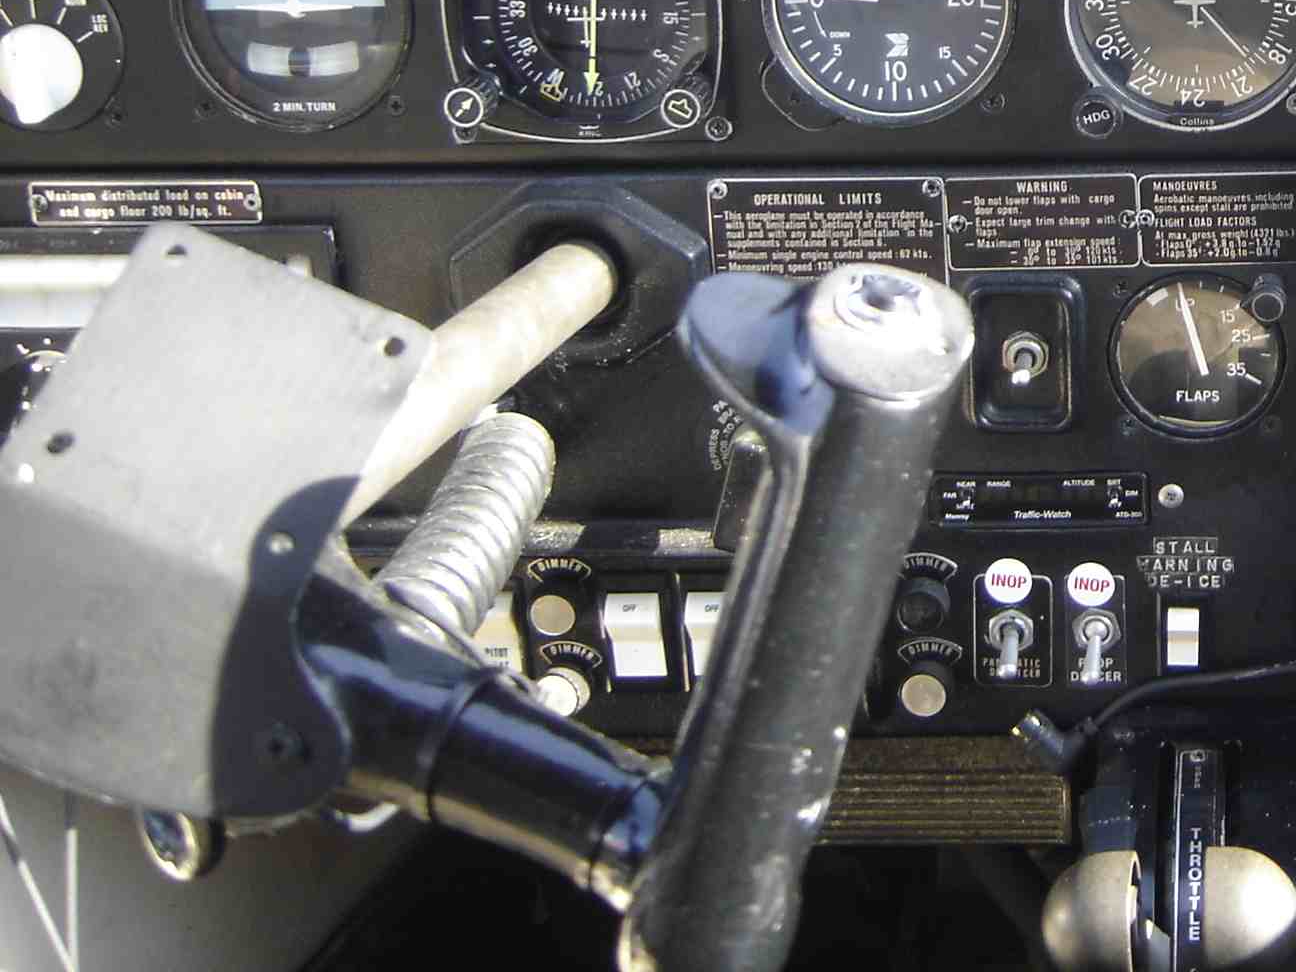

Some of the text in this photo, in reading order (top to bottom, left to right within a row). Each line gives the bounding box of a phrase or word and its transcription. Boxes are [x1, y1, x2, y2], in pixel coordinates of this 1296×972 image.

[885, 61, 907, 81] 10
[1083, 111, 1110, 125] HDG
[1017, 181, 1067, 193] WARNING
[1153, 181, 1217, 190] MANOEUVRES
[45, 189, 243, 201] Maximum distributed load on cabin
[754, 193, 881, 205] OPERATIONAL LIMITS
[974, 195, 1115, 206] Do not lower flaps with cargo
[976, 216, 1115, 227] Expect large trim change with
[1154, 217, 1256, 227] FLIGHT LOAD FACTORS
[1176, 390, 1219, 403] FLAPS
[1014, 510, 1071, 519] Traffic-Watch
[991, 574, 1027, 589] INOP
[1074, 578, 1110, 593] INOP
[1188, 828, 1202, 941] THROTTLE
